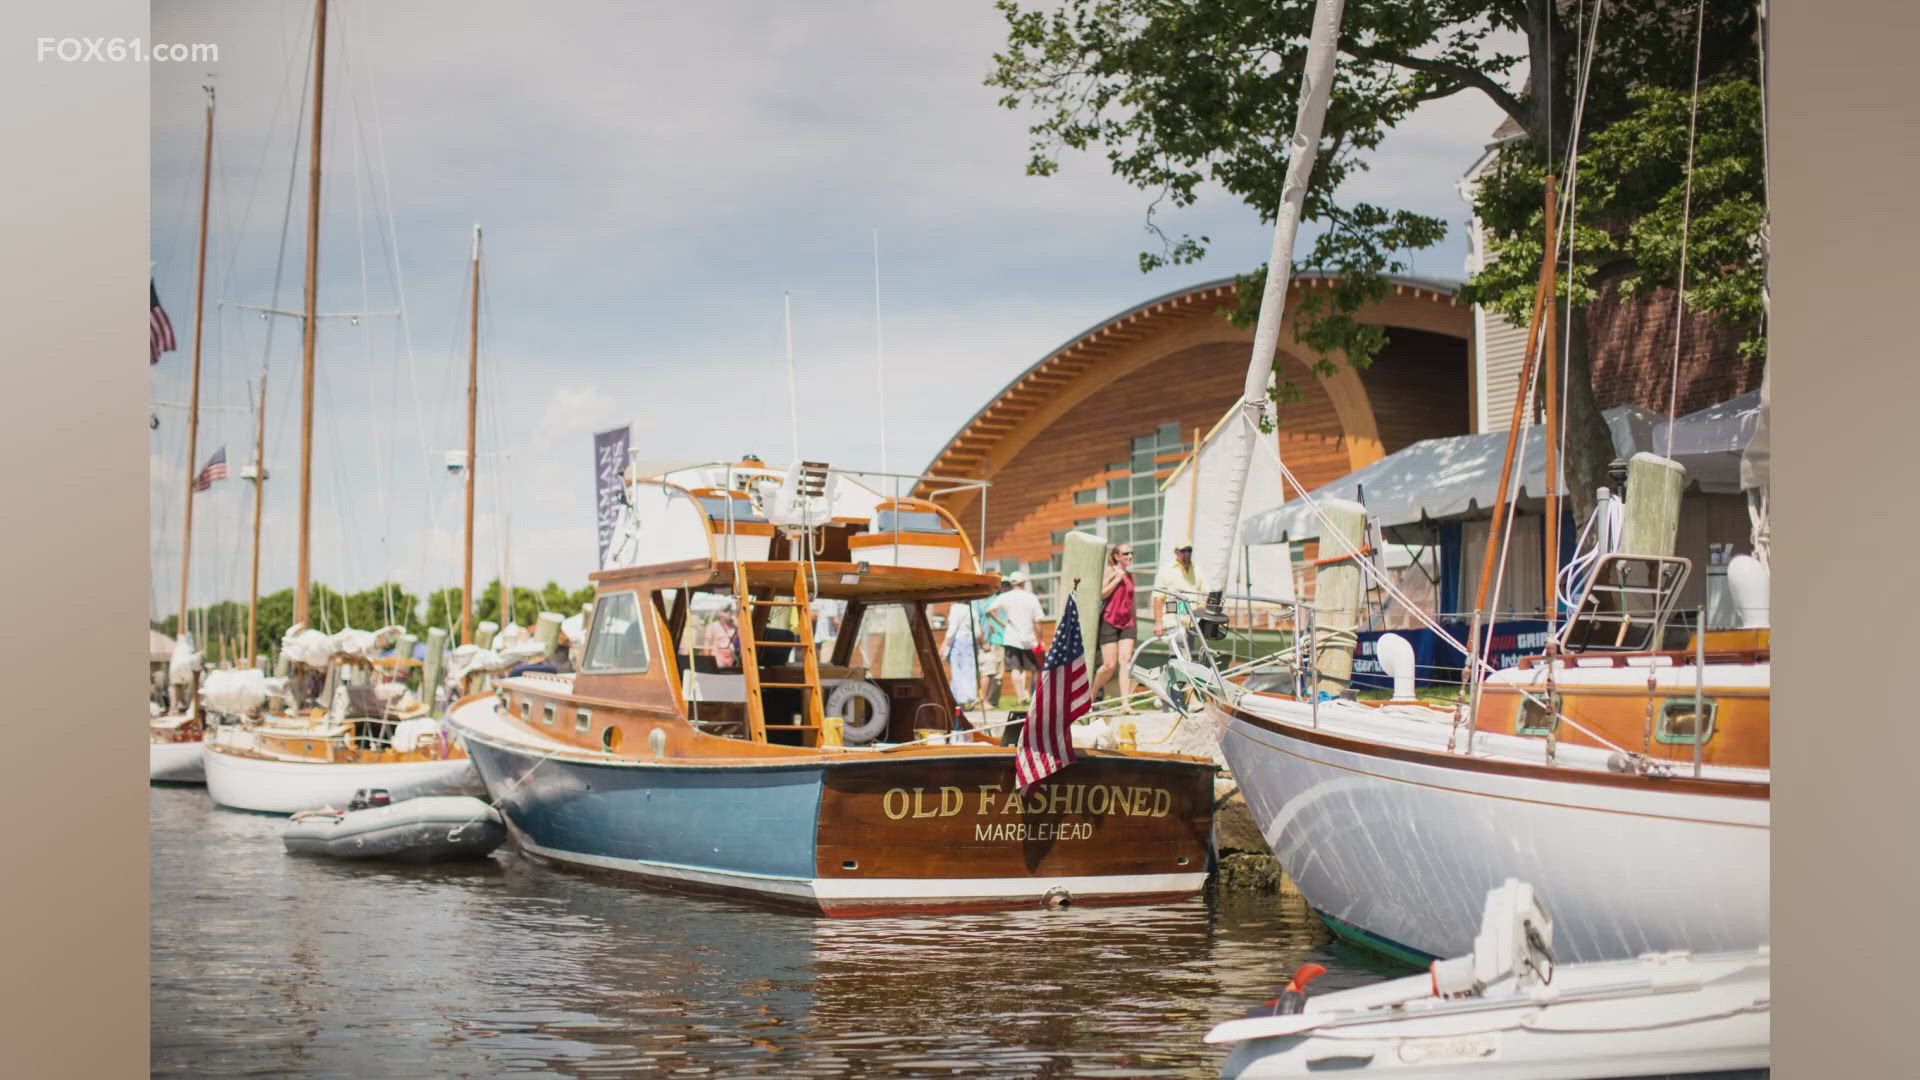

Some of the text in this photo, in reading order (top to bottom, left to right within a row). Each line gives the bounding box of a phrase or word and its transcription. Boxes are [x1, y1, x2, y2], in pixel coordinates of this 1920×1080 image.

[883, 784, 1172, 820] OLD FASHIONED
[975, 822, 1093, 842] MARBLEHEAD
